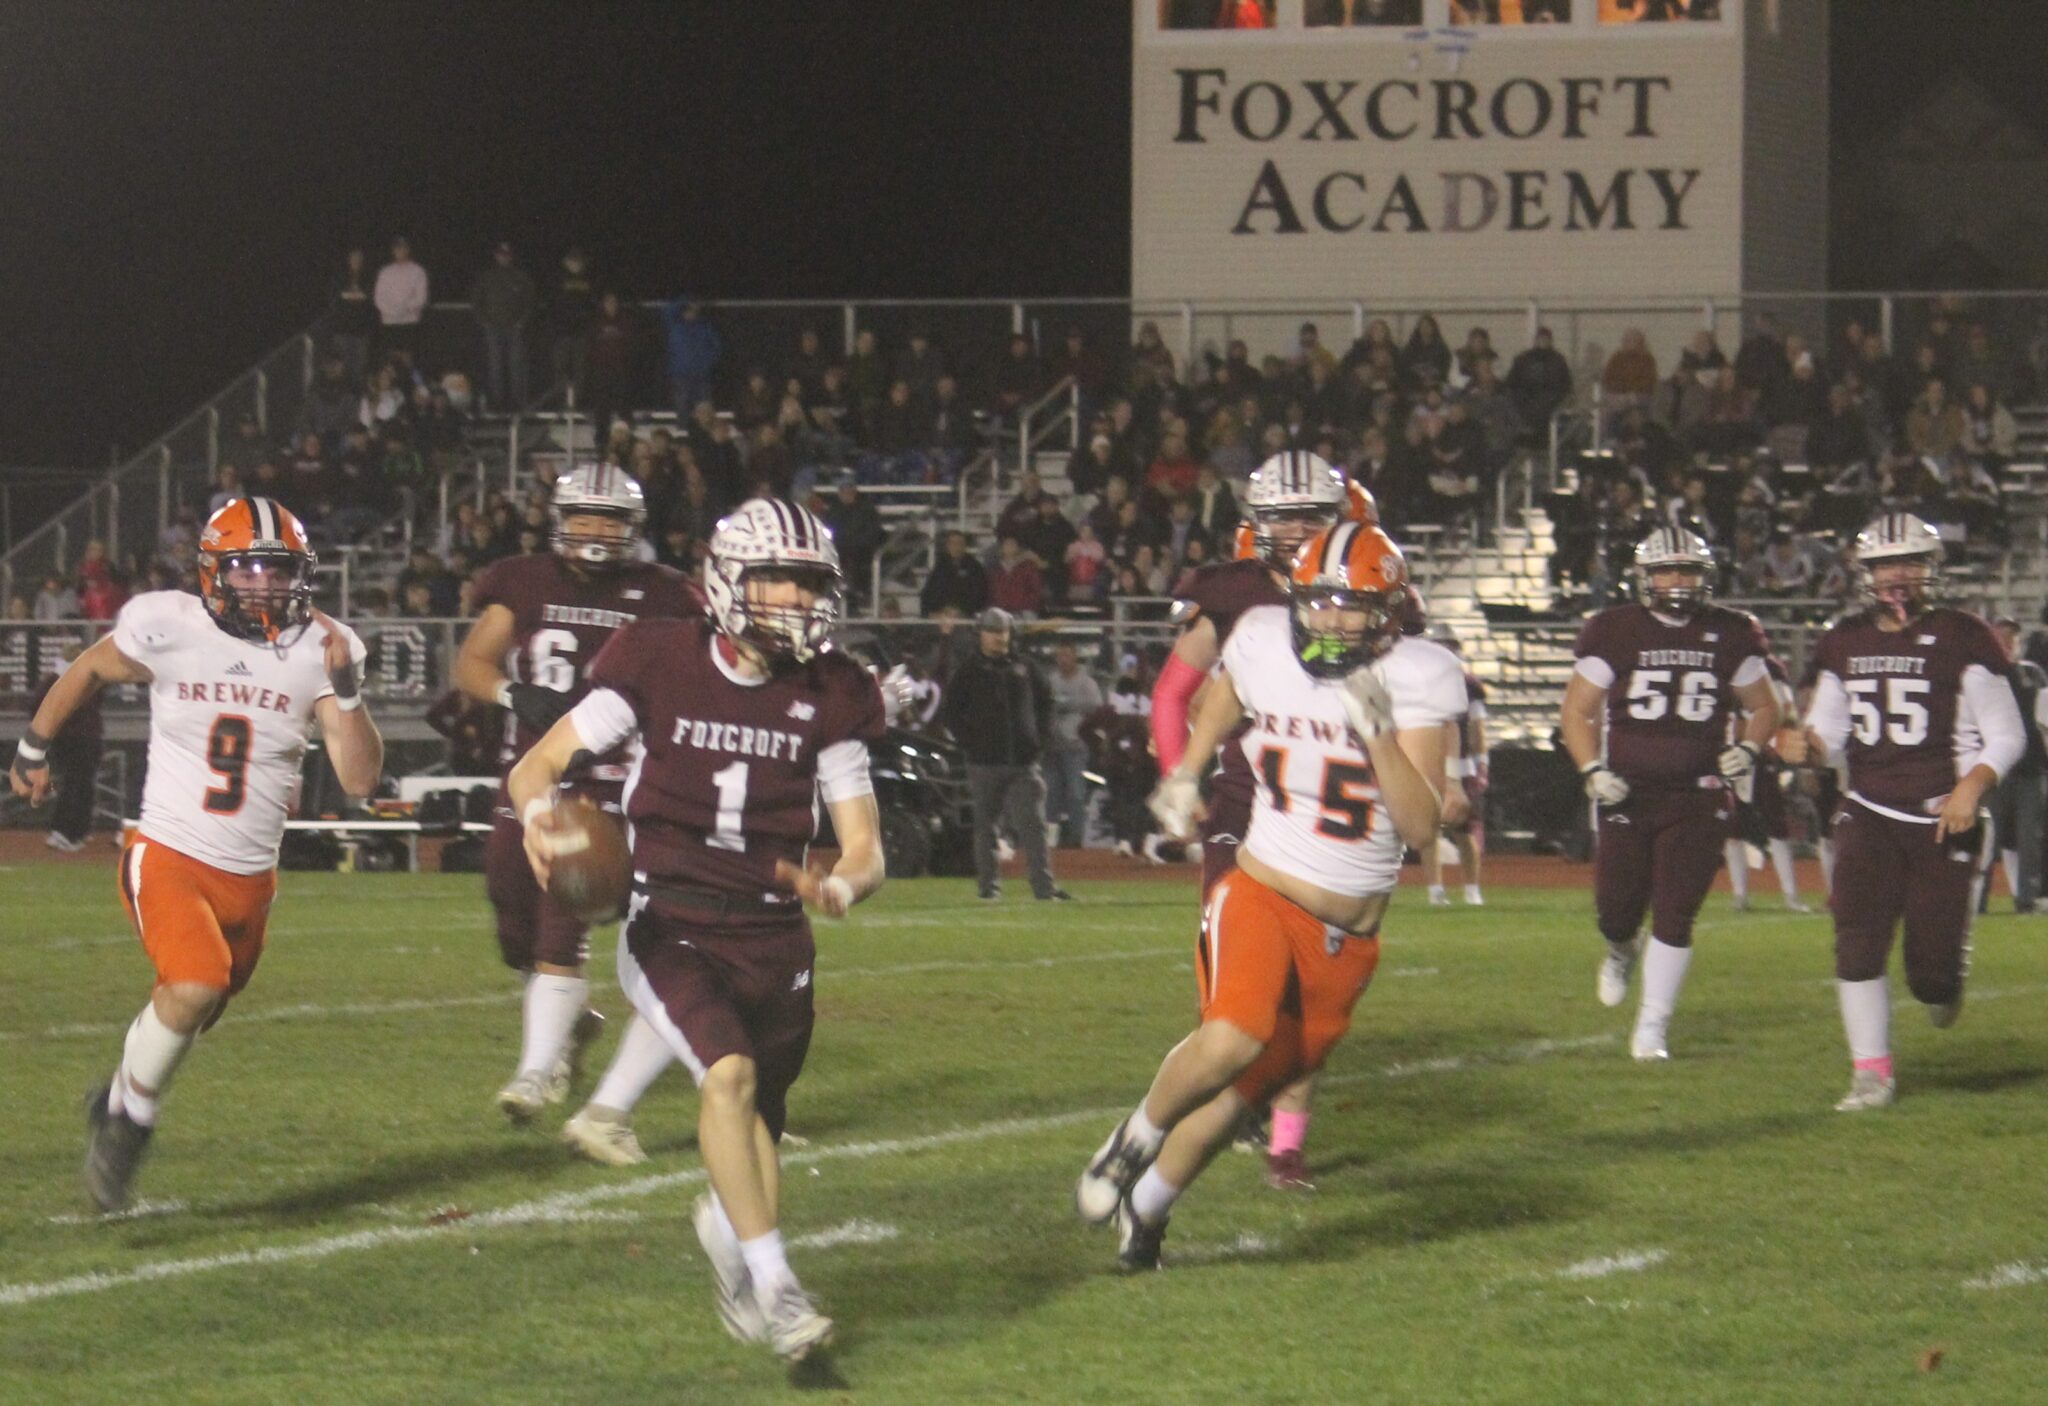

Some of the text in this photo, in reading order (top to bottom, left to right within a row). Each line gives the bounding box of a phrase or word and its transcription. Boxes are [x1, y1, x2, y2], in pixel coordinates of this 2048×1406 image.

[1173, 68, 1672, 143] FOXCROFT
[1230, 159, 1701, 235] ACADEMY
[530, 628, 579, 693] 6
[1638, 649, 1715, 668] FOXCROFT
[1846, 655, 1926, 675] FOXCROFT
[177, 681, 291, 714] BREWER
[1626, 669, 1718, 721] 56
[1844, 678, 1930, 746] 55
[203, 712, 254, 817] 9
[671, 716, 803, 763] FOXCROFT
[705, 760, 750, 854] 1
[1256, 744, 1380, 845] 15
